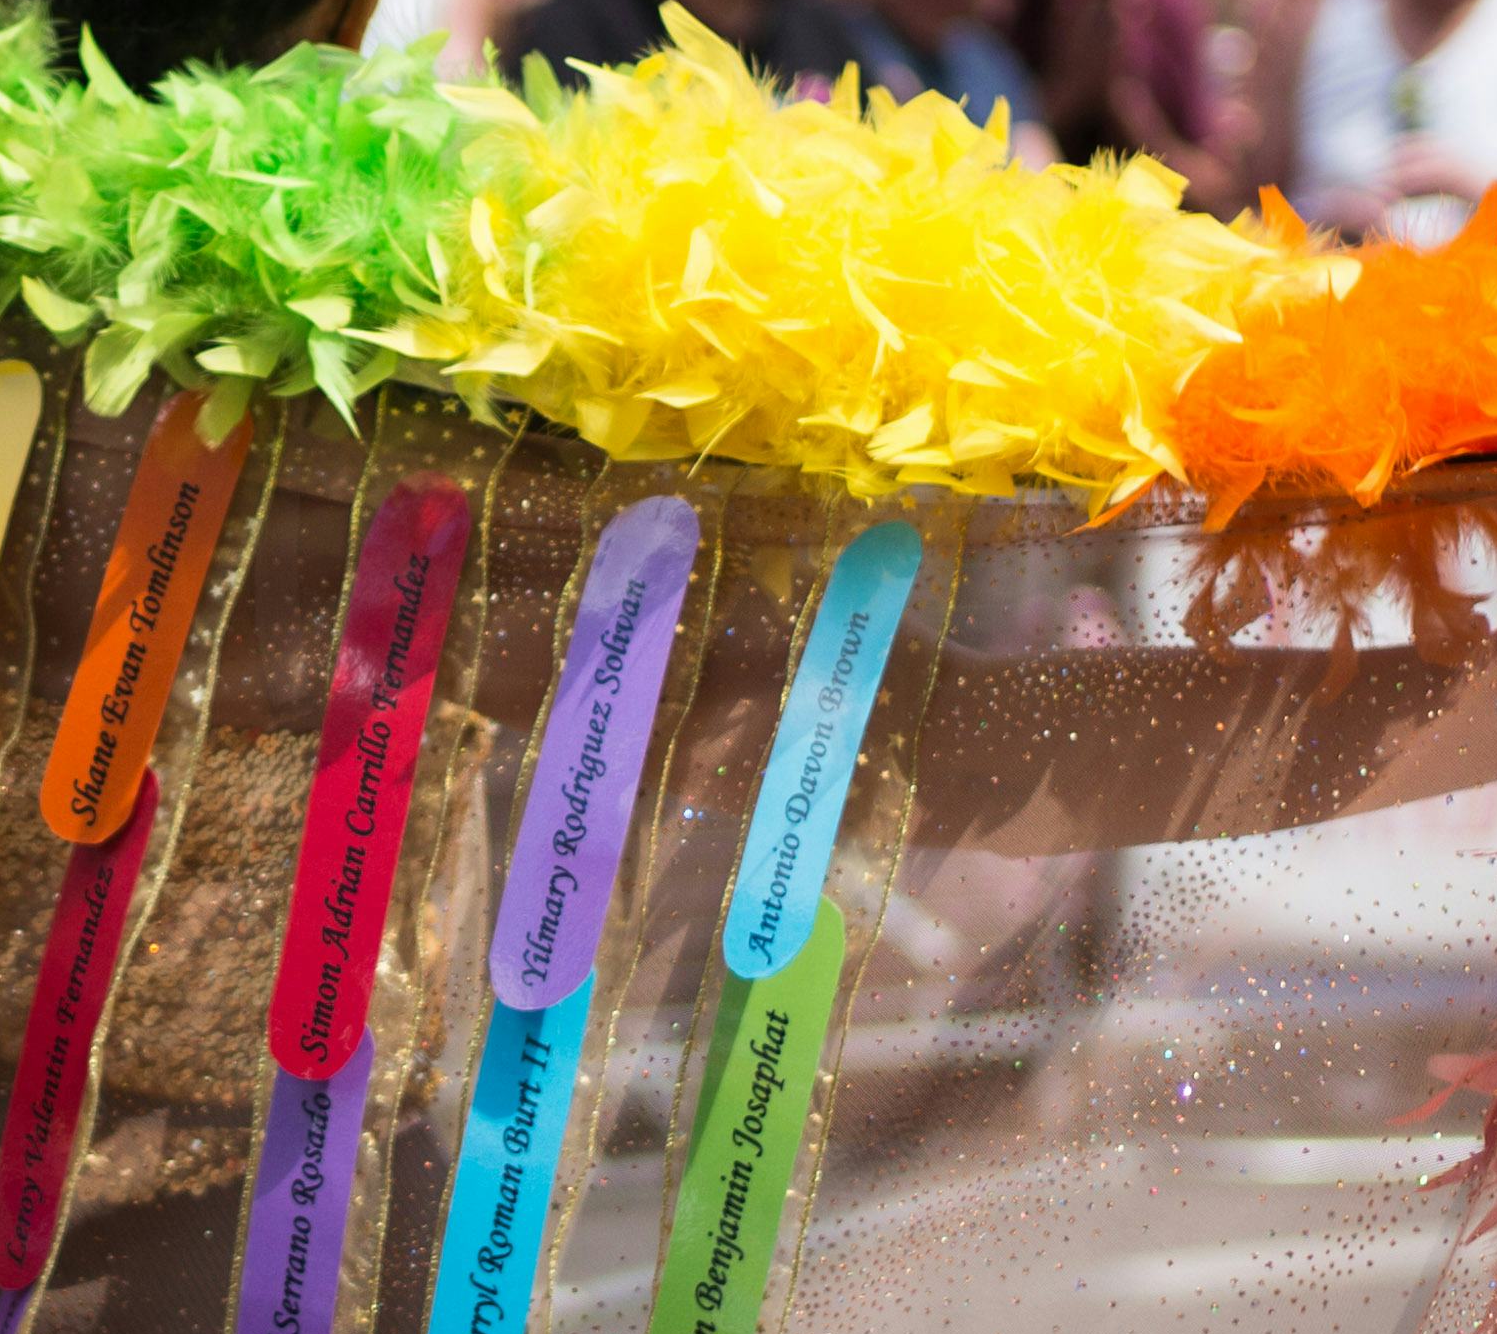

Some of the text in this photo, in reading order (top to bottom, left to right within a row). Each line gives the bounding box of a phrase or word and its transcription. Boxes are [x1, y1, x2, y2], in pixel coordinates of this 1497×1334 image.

[71, 483, 200, 827] Shane Evan Tomlinson
[300, 553, 429, 1063] Simon Adrian Carrillo Fernandez
[522, 581, 646, 986] Yilmary Rodriguez Solivan
[748, 612, 869, 965] Antonio Davon Brown
[6, 868, 112, 1268] Leroy Valentin Fernandez
[291, 1091, 331, 1205] Rosado
[503, 1080, 541, 1154] Burt
[520, 1033, 550, 1070] II
[695, 1160, 752, 1311] Benjamin
[732, 1009, 788, 1157] Josaphat
[477, 1164, 523, 1273] Roman
